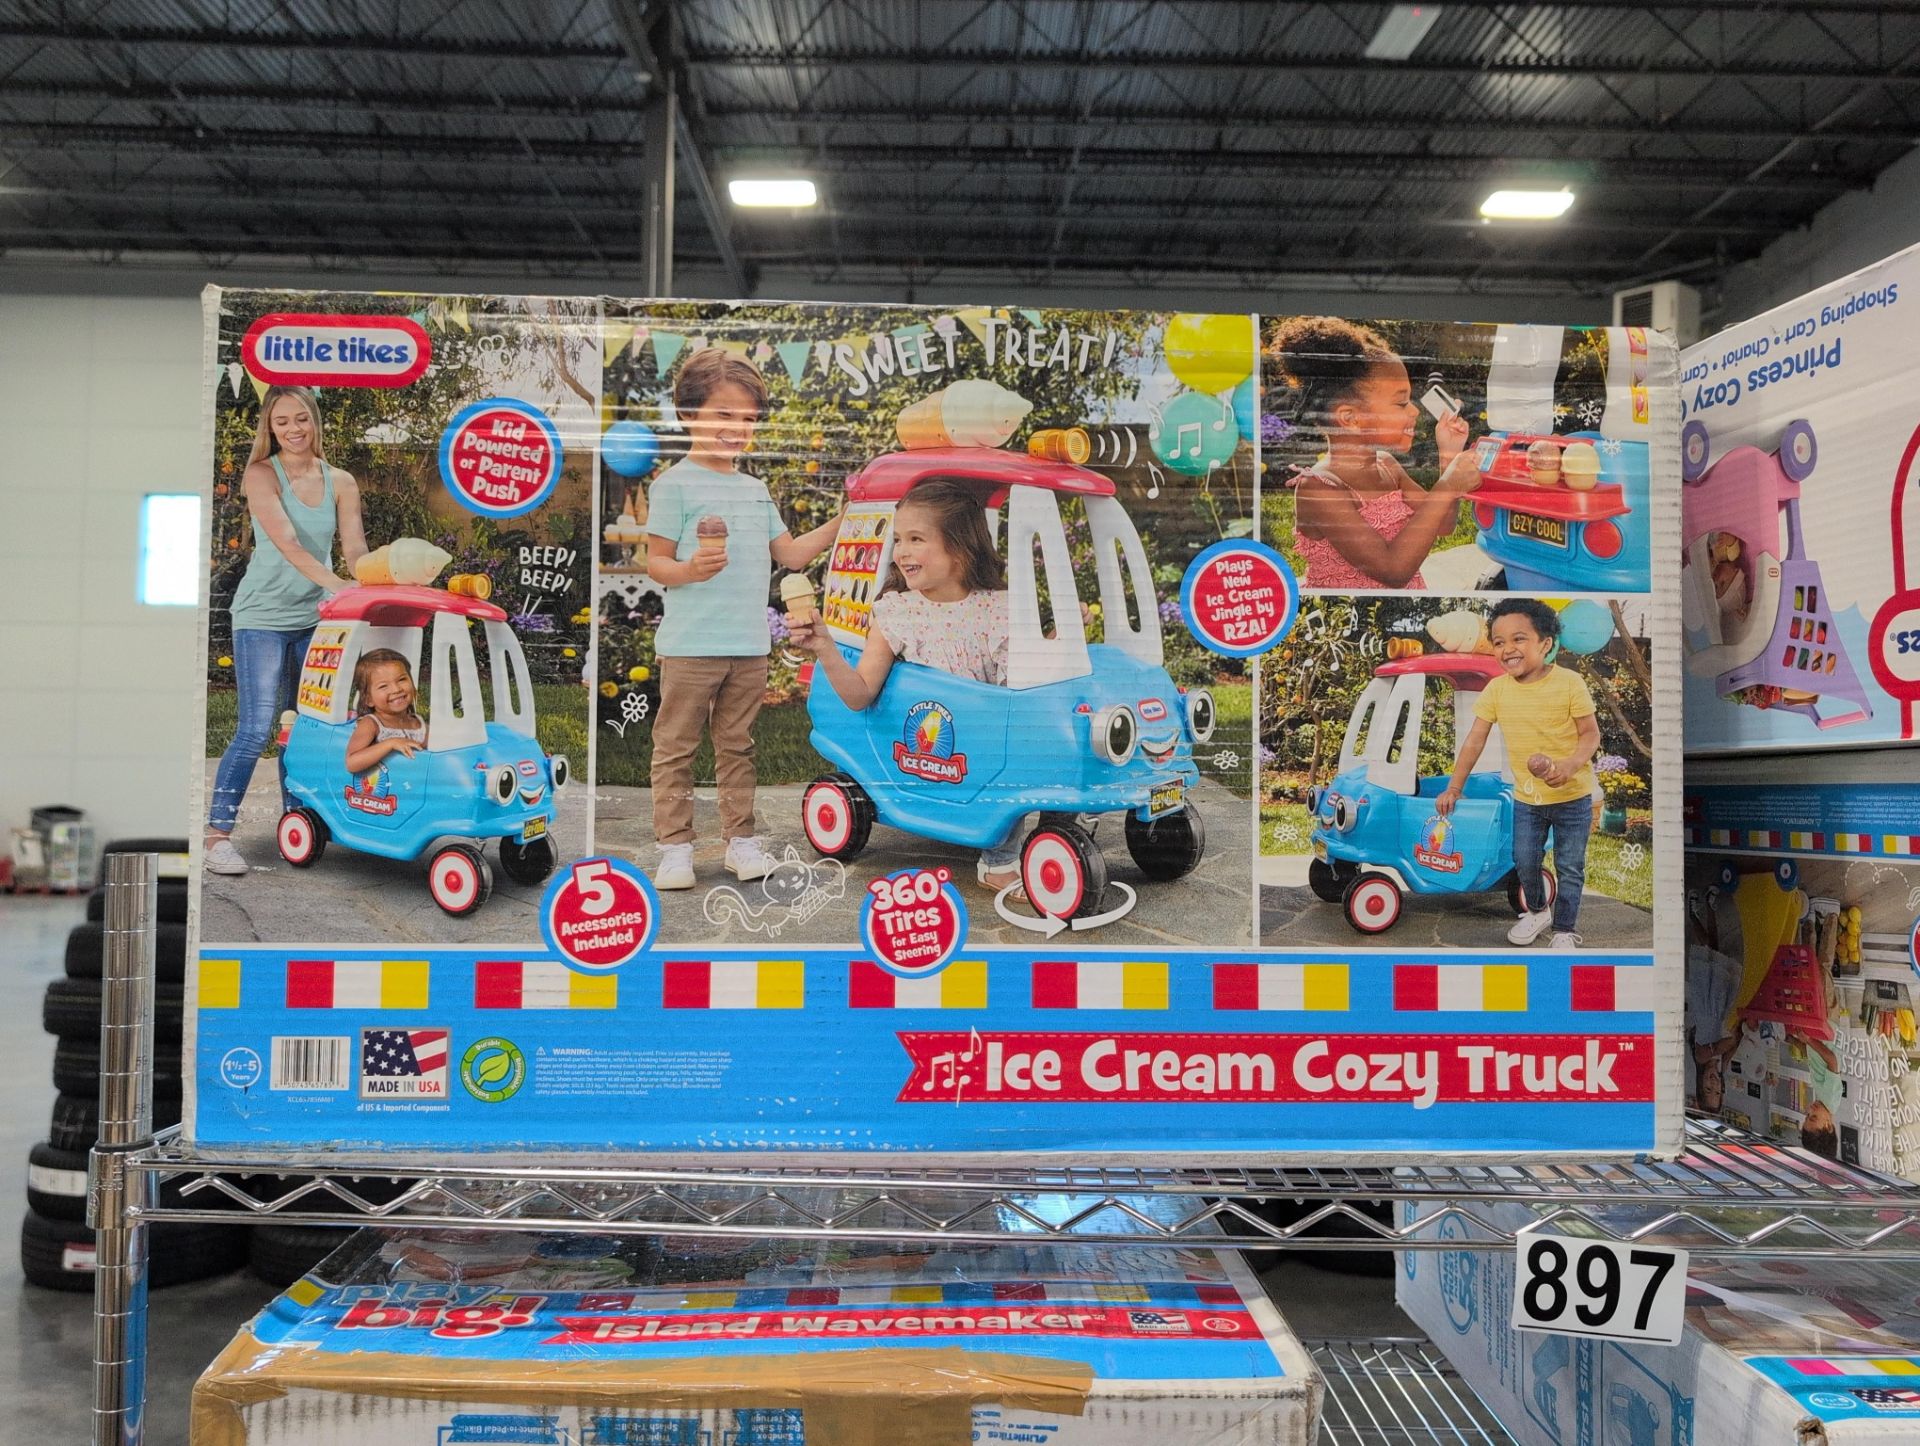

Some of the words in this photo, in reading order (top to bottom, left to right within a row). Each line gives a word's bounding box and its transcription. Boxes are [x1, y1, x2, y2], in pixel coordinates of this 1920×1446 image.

[1822, 284, 1898, 321] Shopping
[1785, 317, 1816, 341] Cart
[264, 335, 331, 362] little
[338, 336, 410, 364] tikes
[836, 329, 962, 396] SWEET
[979, 317, 1117, 378] TREAT!
[1721, 336, 1769, 367] Chariot
[1681, 362, 1709, 384] Carr
[1748, 337, 1841, 391] Princess
[1693, 378, 1741, 414] Cozy
[492, 419, 525, 441] Kid
[463, 432, 543, 463] Powered
[460, 458, 476, 471] or
[478, 459, 542, 485] Parent
[471, 476, 521, 502] Push
[1536, 519, 1563, 541] COOL
[519, 546, 577, 568] BEEP!
[1216, 558, 1253, 575] Plays
[520, 568, 572, 595] BEEP!
[1223, 573, 1251, 588] New
[1206, 592, 1230, 607] Ice
[1230, 586, 1273, 605] Cream
[1211, 603, 1253, 622] Jingle
[1255, 601, 1275, 619] by
[1223, 620, 1268, 640] RZA!
[902, 756, 919, 771] ICE
[920, 758, 958, 778] CREAM
[350, 795, 363, 806] ICE
[363, 797, 391, 812] CREAM
[1419, 853, 1430, 863] ICE
[1431, 856, 1457, 870] CREAM
[574, 863, 615, 915] 5
[561, 912, 642, 937] Accessories
[879, 906, 941, 935] Tires
[573, 930, 634, 953] Included
[891, 935, 908, 947] for
[910, 931, 938, 947] Easy
[894, 943, 942, 961] Steering
[552, 1048, 593, 1056] WARNING:
[986, 1042, 1061, 1092] Ice
[1081, 1039, 1275, 1093] Cream
[1292, 1040, 1440, 1110] Cozy
[368, 1081, 399, 1093] MADE
[403, 1081, 415, 1092] IN
[418, 1080, 441, 1093] USA
[357, 1104, 365, 1112] of
[365, 1104, 374, 1112] US
[376, 1104, 382, 1112] &
[383, 1104, 411, 1113] Imported
[413, 1104, 450, 1113] Components
[1853, 1102, 1873, 1126] PAS
[1894, 1130, 1919, 1152] THE
[1869, 1155, 1905, 1176] FORGET
[342, 1282, 503, 1303] play
[1523, 1239, 1676, 1330] 897
[338, 1296, 546, 1338] big!
[593, 1316, 757, 1340] Island
[988, 1431, 1048, 1444] #LittleTikes
